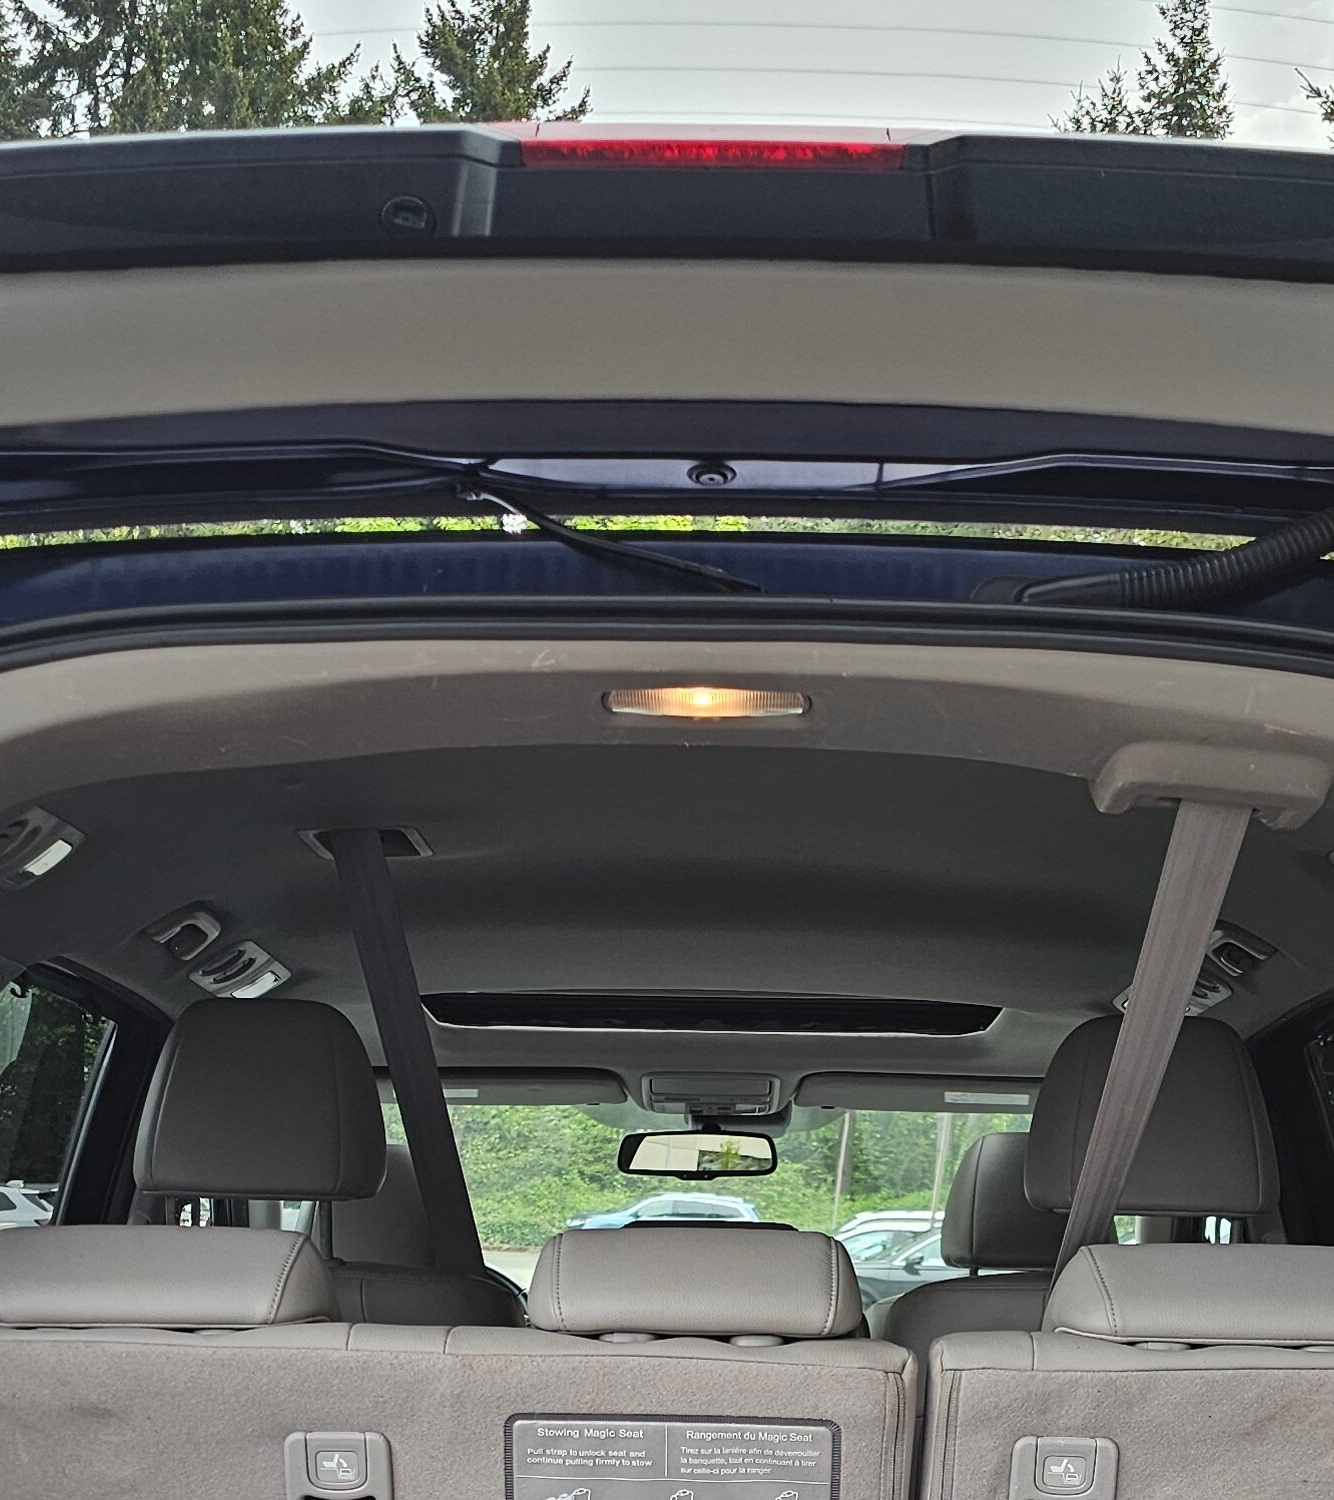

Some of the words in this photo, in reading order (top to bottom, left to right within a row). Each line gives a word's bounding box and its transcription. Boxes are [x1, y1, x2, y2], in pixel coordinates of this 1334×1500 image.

[536, 1427, 580, 1439] Stowing
[584, 1428, 616, 1440] Magic
[618, 1429, 644, 1438] Seat
[686, 1430, 741, 1442] Rangement
[743, 1431, 756, 1440] du
[758, 1432, 787, 1444] Magic
[789, 1432, 813, 1442] Seat
[545, 1448, 567, 1457] strap
[579, 1449, 607, 1457] unlock
[629, 1450, 646, 1458] and
[680, 1446, 700, 1455] Tirez
[713, 1447, 721, 1455] la
[763, 1448, 773, 1456] de
[526, 1456, 564, 1465] continue
[565, 1457, 594, 1467] pulling
[595, 1458, 620, 1467] firmly
[631, 1459, 653, 1467] stow
[755, 1458, 793, 1466] continuant
[801, 1459, 817, 1467] tirer
[720, 1468, 737, 1476] pour
